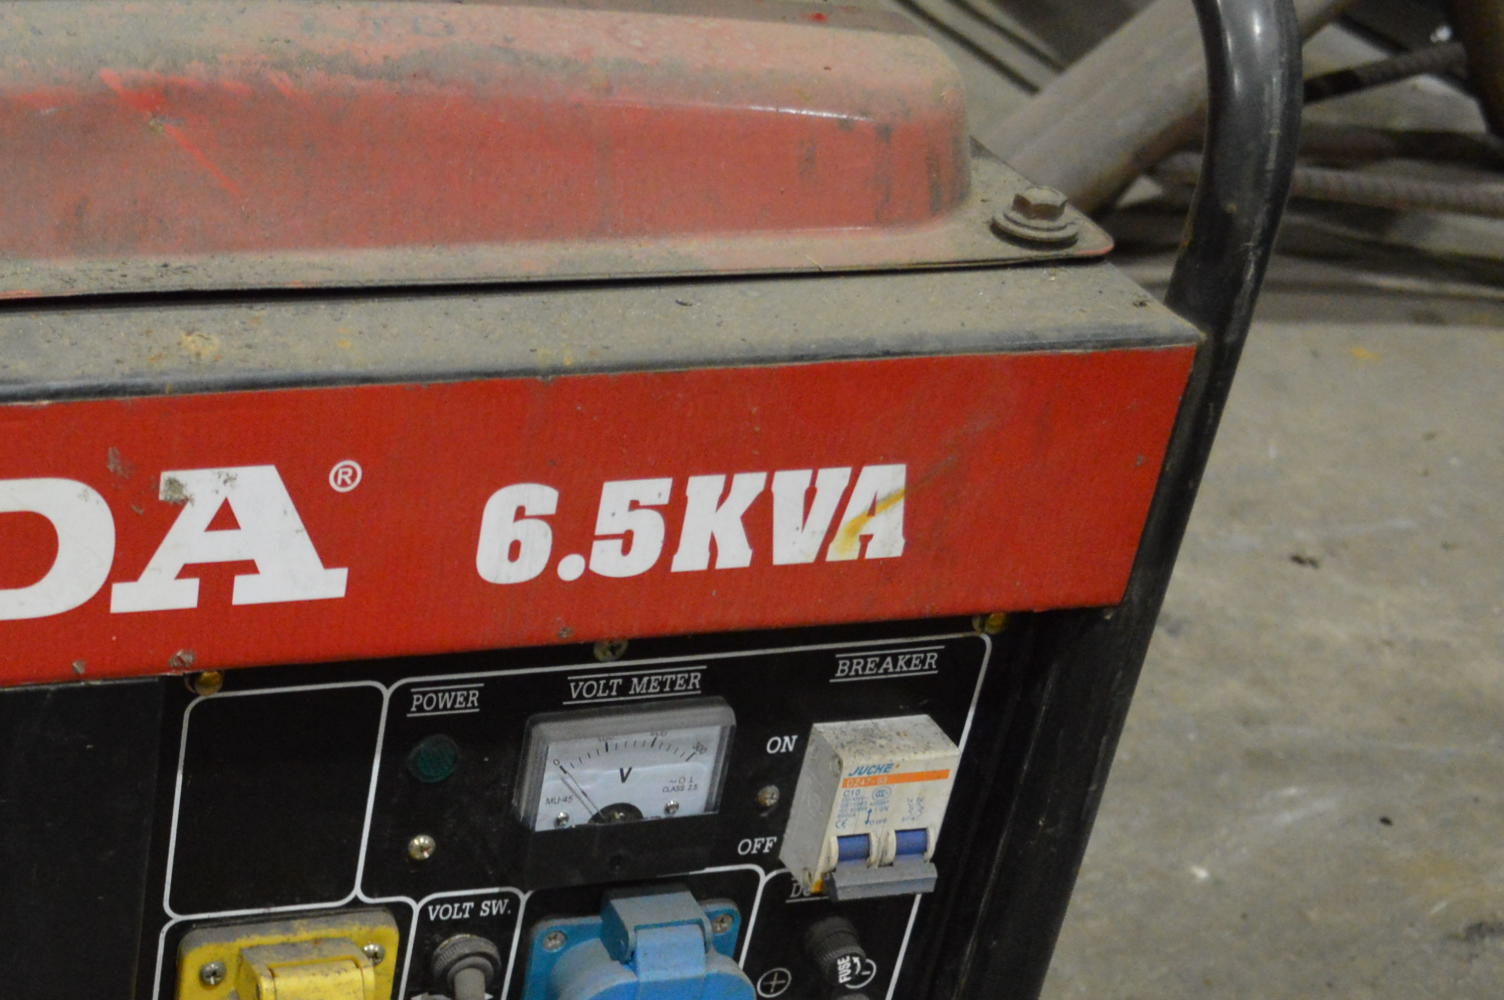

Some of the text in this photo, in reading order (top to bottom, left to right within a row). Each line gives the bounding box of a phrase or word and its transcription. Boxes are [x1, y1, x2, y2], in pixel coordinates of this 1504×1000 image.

[474, 463, 908, 585] 6.5KVA
[835, 653, 938, 677] BREAKER
[570, 672, 702, 699] VOLT METER
[410, 690, 479, 711] POWER
[766, 735, 798, 754] ON
[619, 767, 632, 784] V
[737, 836, 777, 855] OFF
[428, 899, 511, 921] VOLT SW.
[836, 955, 853, 984] FUSE
